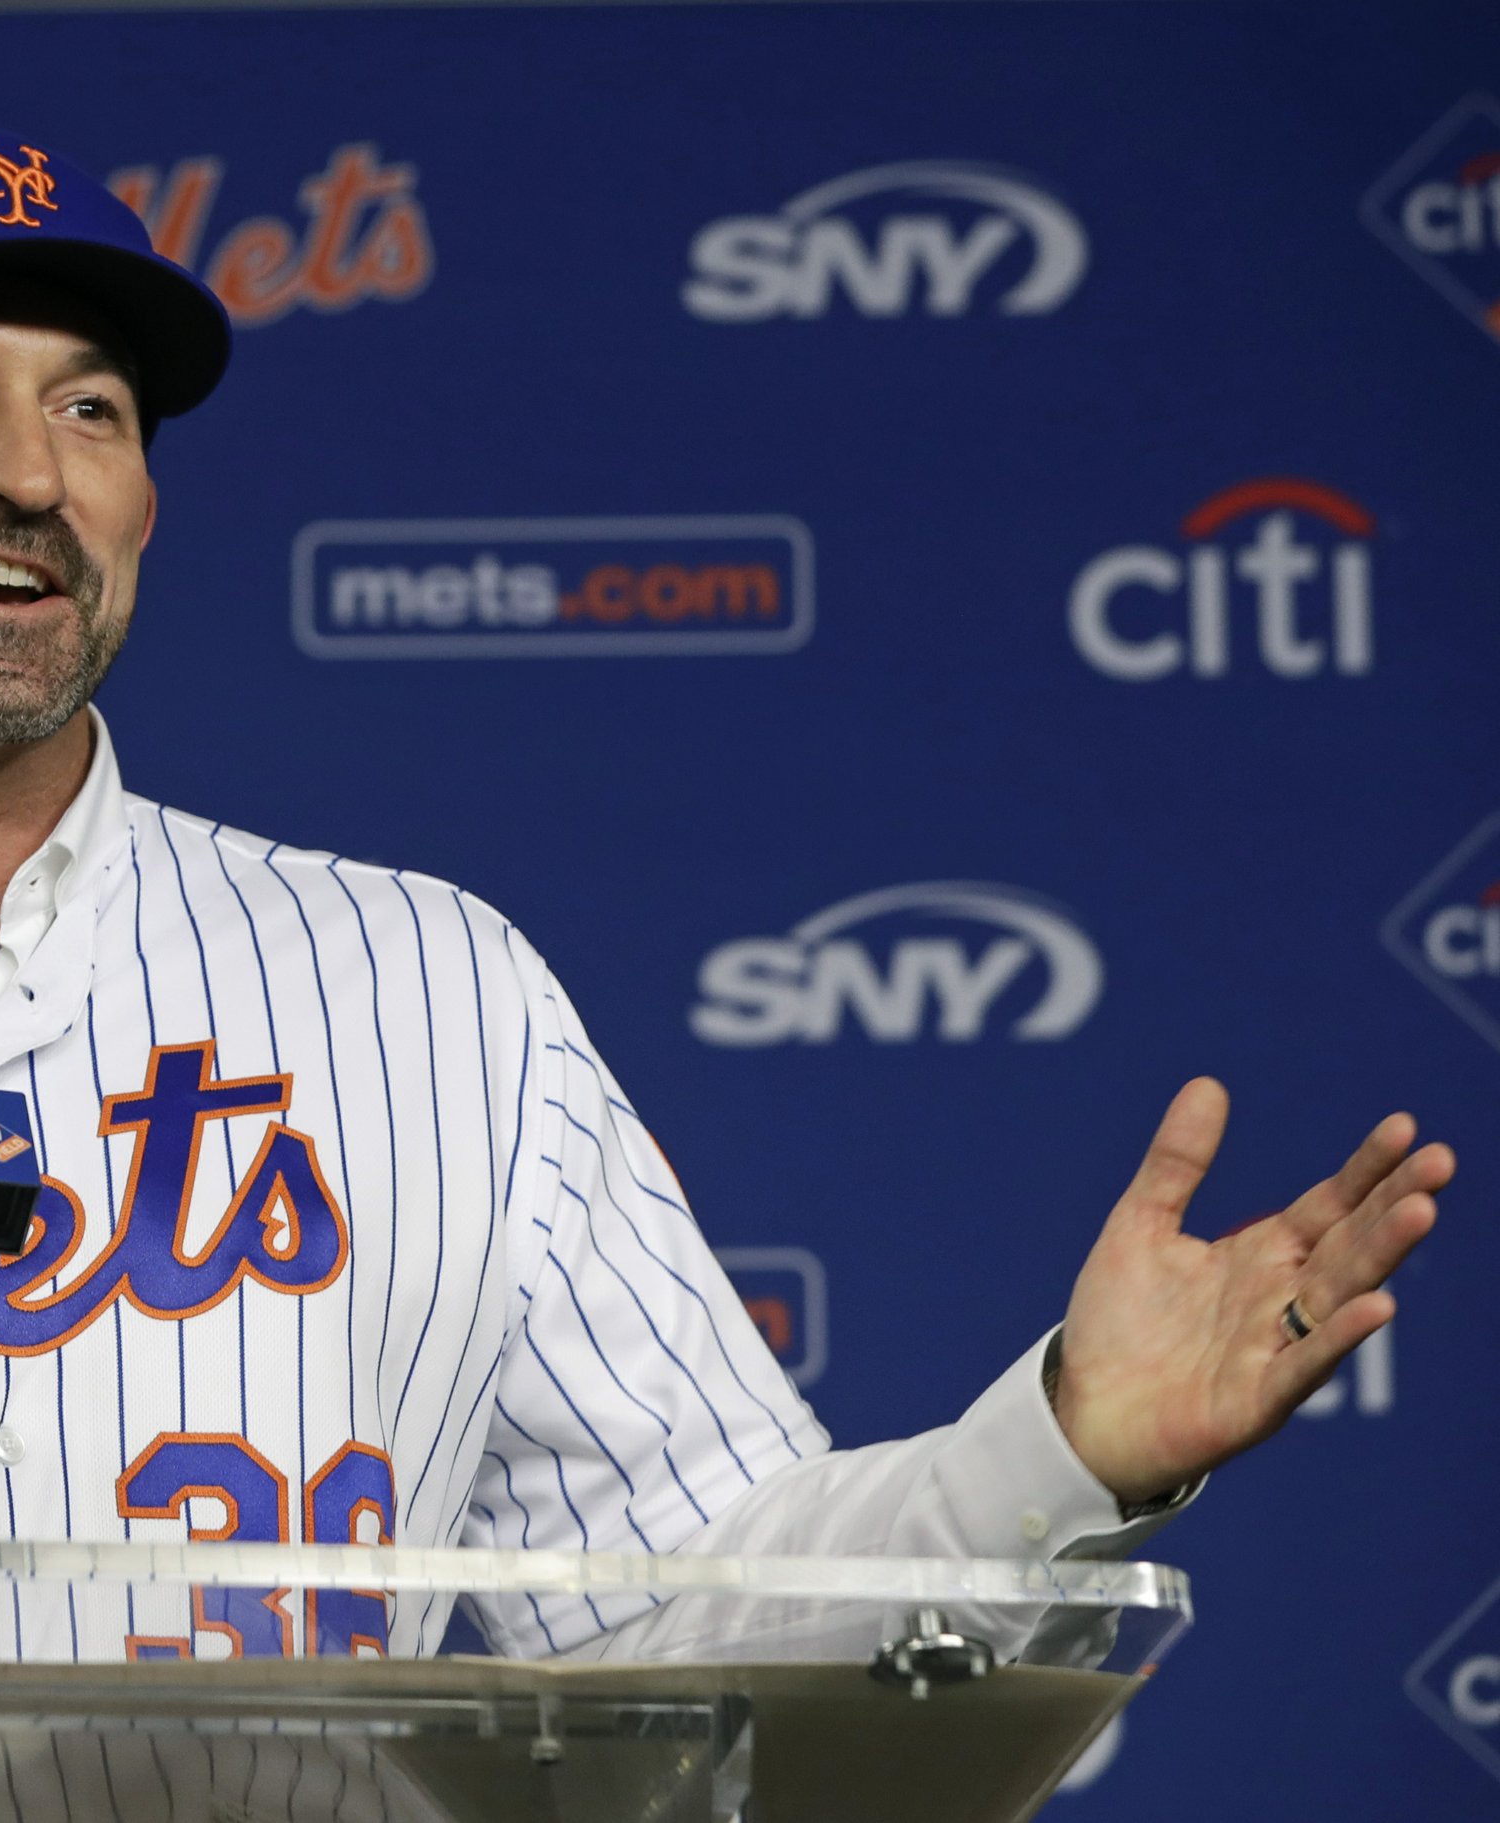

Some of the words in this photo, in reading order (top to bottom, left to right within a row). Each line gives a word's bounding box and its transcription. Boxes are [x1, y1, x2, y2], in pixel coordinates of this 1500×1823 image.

[682, 216, 1019, 321] SNY
[332, 553, 780, 627] mets.com
[1069, 513, 1370, 679] citi
[690, 940, 1035, 1046] SNY
